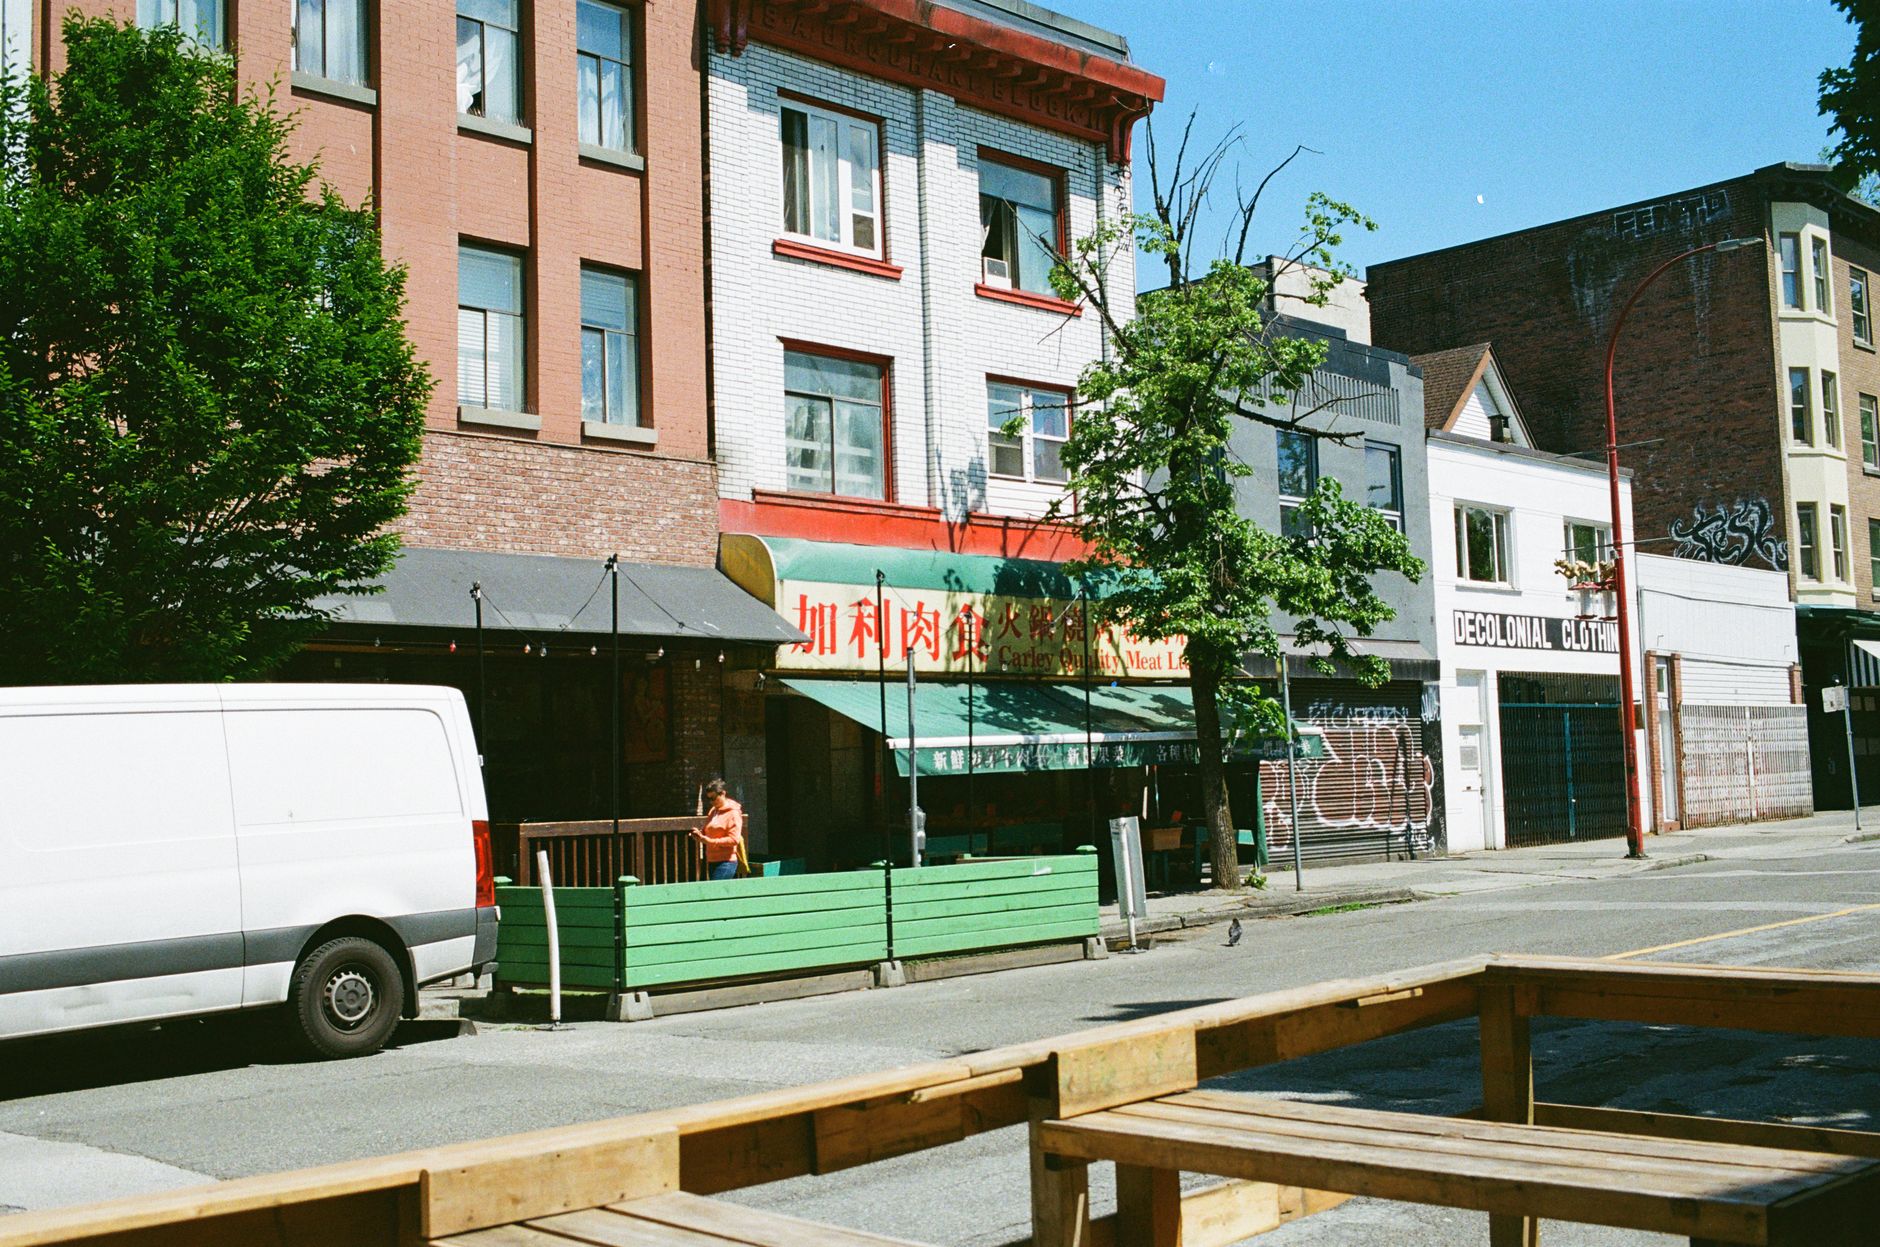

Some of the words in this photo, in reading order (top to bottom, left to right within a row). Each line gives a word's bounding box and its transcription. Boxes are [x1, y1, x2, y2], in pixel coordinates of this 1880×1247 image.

[791, 594, 989, 662] 加利肉食
[1454, 611, 1552, 649] DECOLONIAL
[1561, 619, 1618, 652] CLOTHIN
[1000, 645, 1053, 677] Carley
[1060, 647, 1121, 674] Quality
[1126, 652, 1162, 671] Meat
